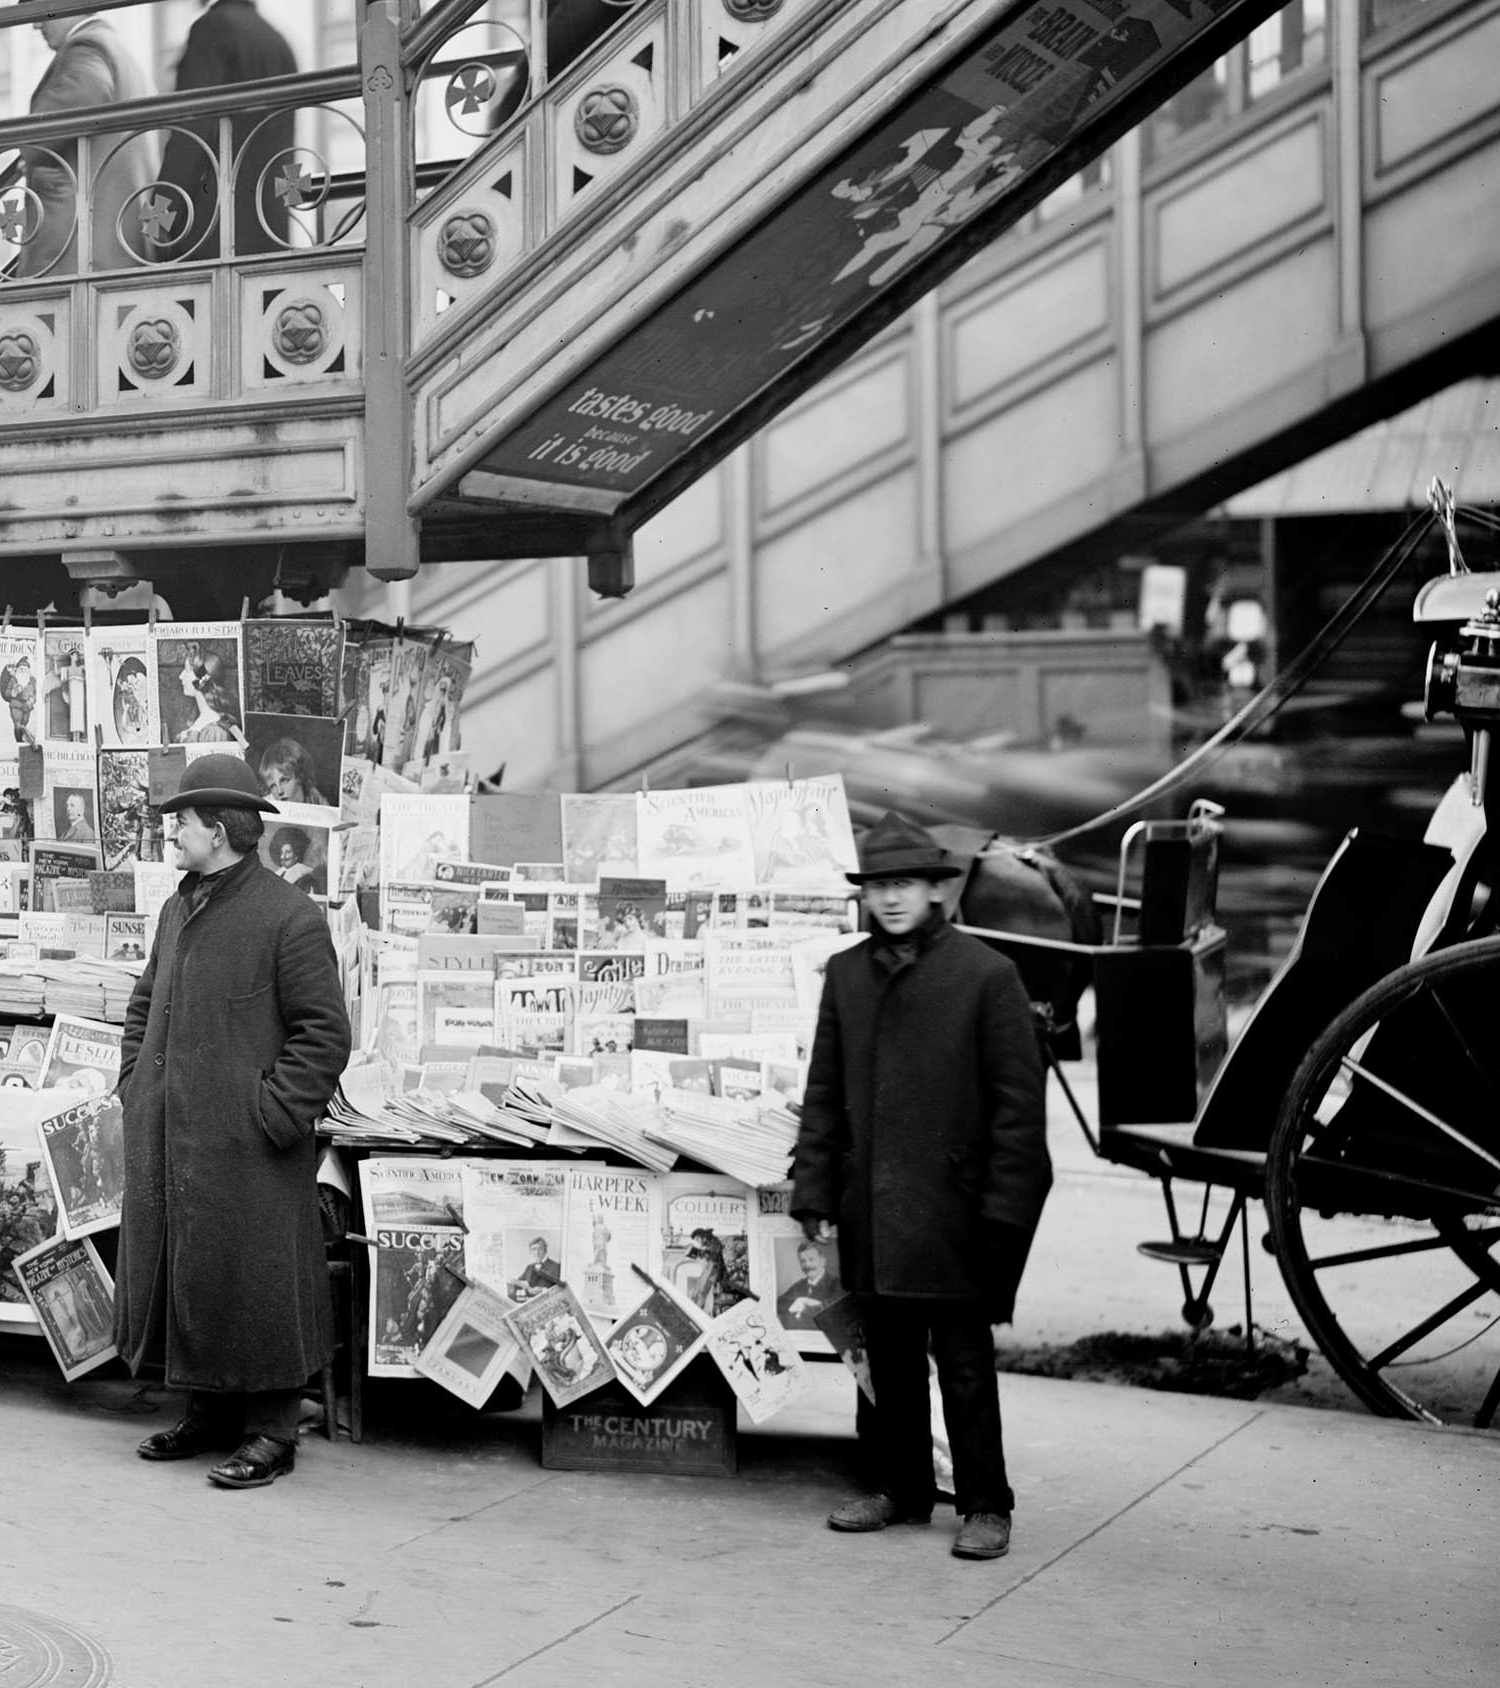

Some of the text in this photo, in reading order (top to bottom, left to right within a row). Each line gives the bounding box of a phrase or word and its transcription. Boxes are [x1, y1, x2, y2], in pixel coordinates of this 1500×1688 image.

[568, 387, 713, 435] tastes good
[584, 425, 639, 446] because
[529, 433, 651, 475] it is good
[266, 659, 323, 685] LEAVES
[111, 922, 145, 934] SUNSE
[418, 1168, 462, 1183] AMERICA
[572, 1175, 647, 1193] HARPER'S
[598, 1194, 649, 1213] WEEK
[377, 1231, 464, 1250] SUCCES
[603, 1417, 712, 1440] CENTURY
